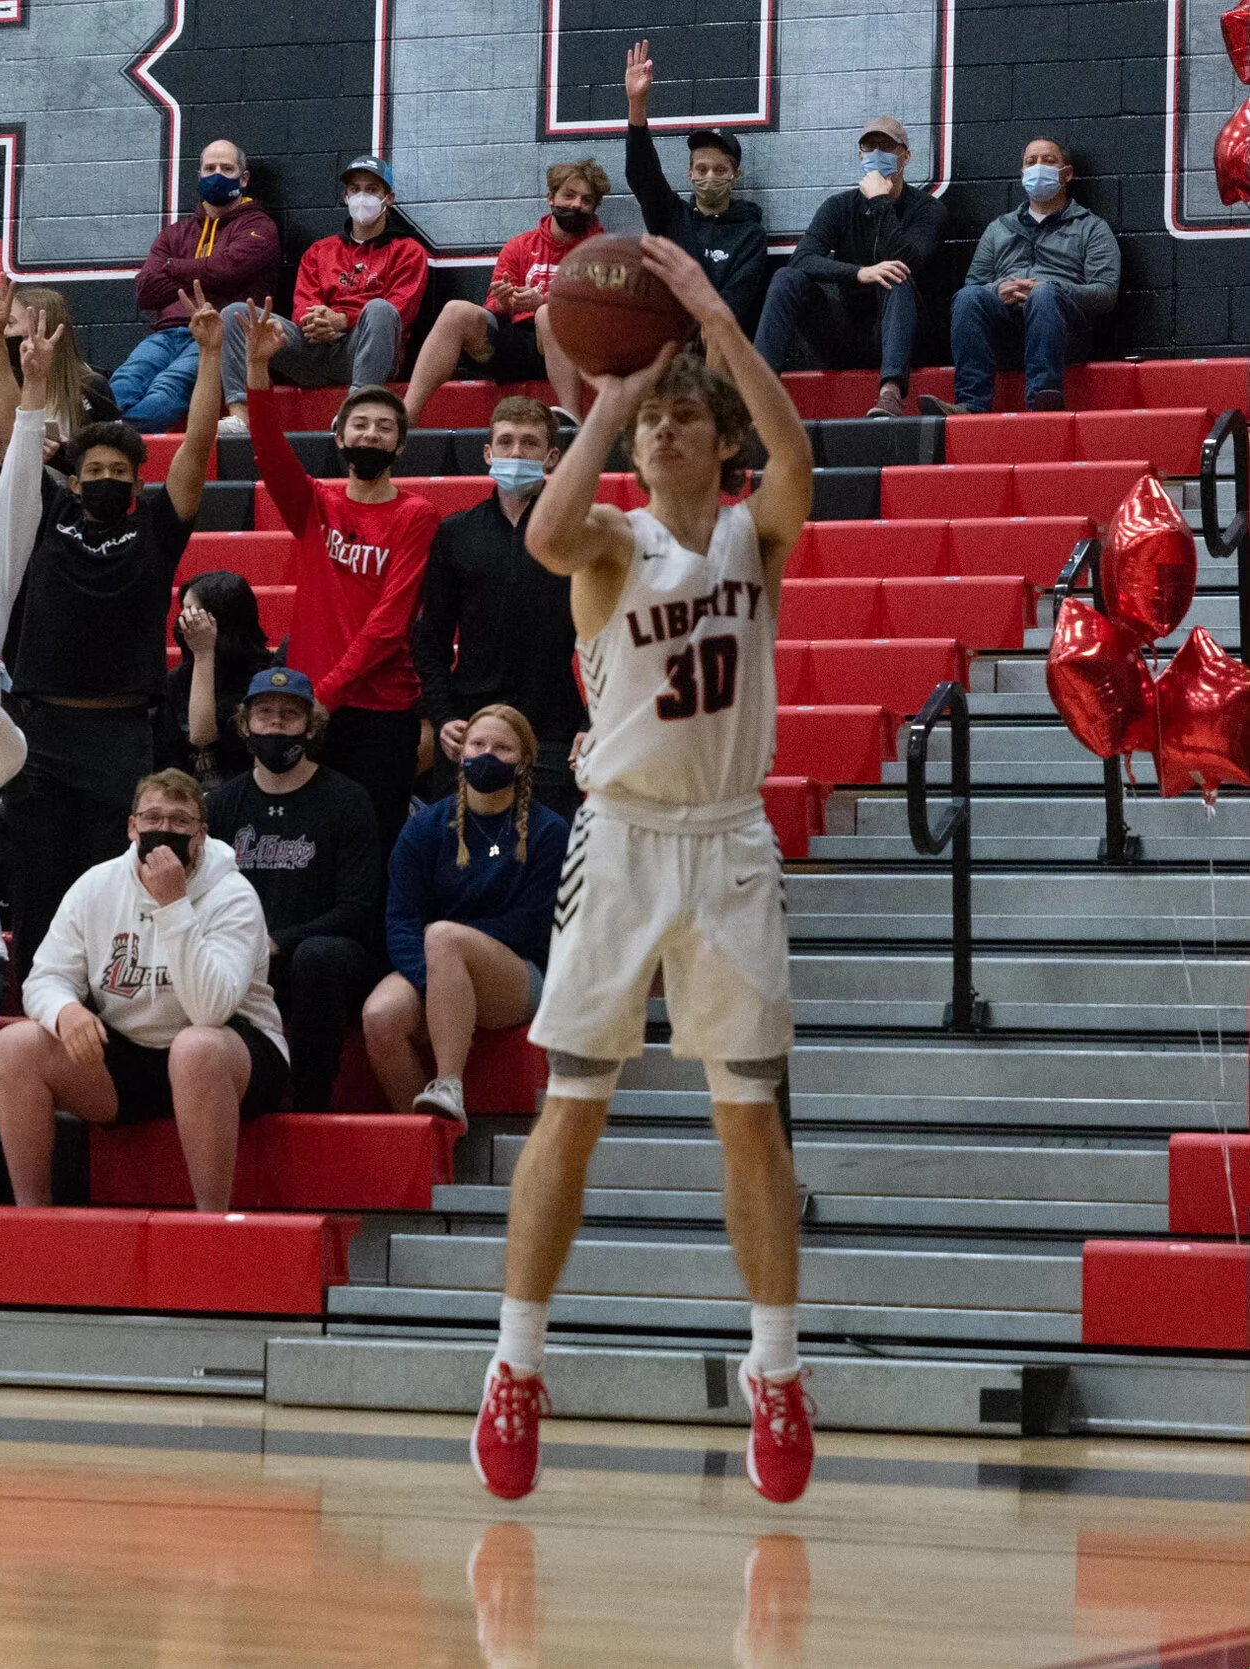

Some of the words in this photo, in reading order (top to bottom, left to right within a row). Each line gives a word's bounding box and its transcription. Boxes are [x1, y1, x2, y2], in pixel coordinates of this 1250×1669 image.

[56, 523, 138, 555] Chmpion
[321, 524, 390, 576] BERTY
[655, 633, 738, 722] 30
